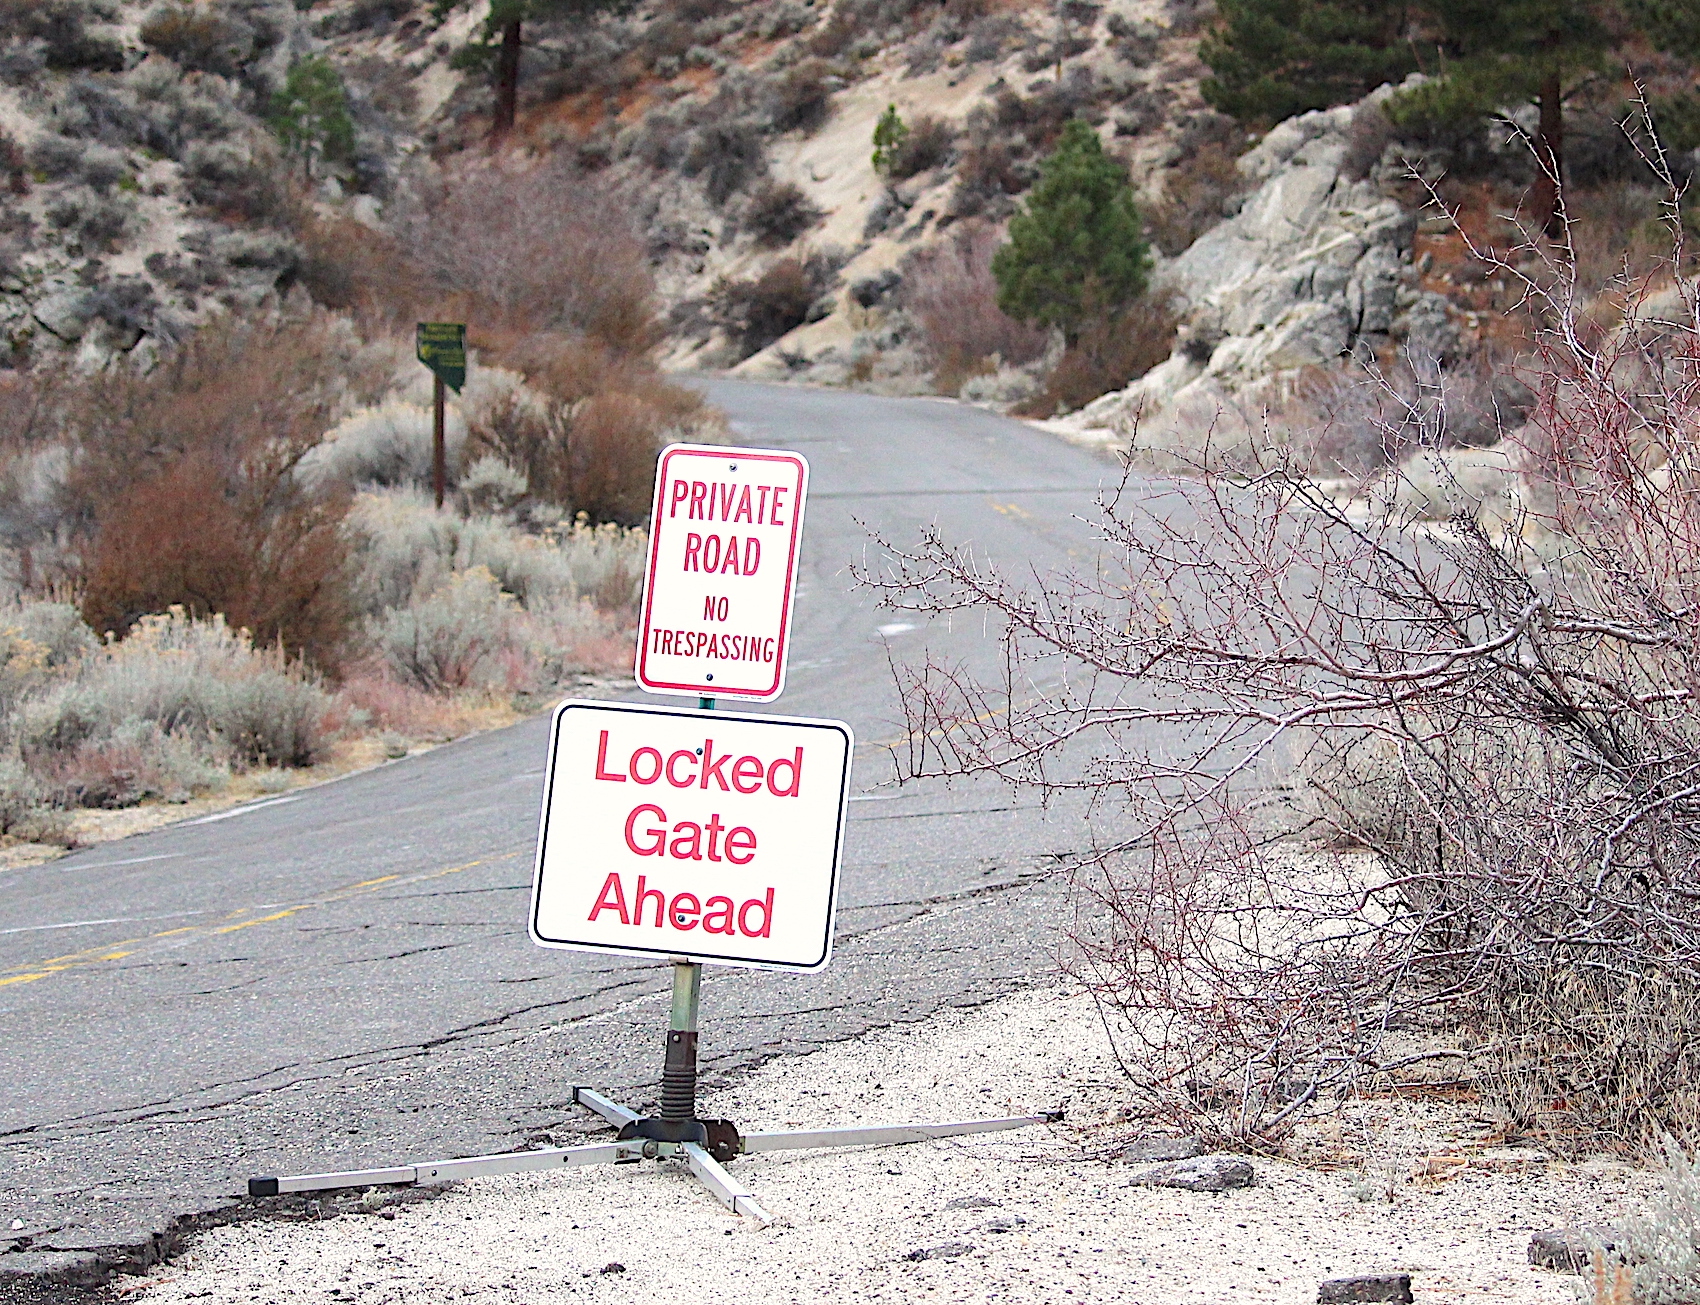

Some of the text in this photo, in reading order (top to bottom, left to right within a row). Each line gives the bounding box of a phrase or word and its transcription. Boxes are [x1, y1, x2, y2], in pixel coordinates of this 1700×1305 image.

[670, 480, 788, 526] PRIVATE
[684, 533, 761, 576] ROAD
[704, 596, 729, 622] NO
[653, 629, 774, 663] TRESPASSING
[595, 730, 804, 798] Locked
[625, 803, 757, 865] Gate
[588, 872, 775, 939] Ahead
